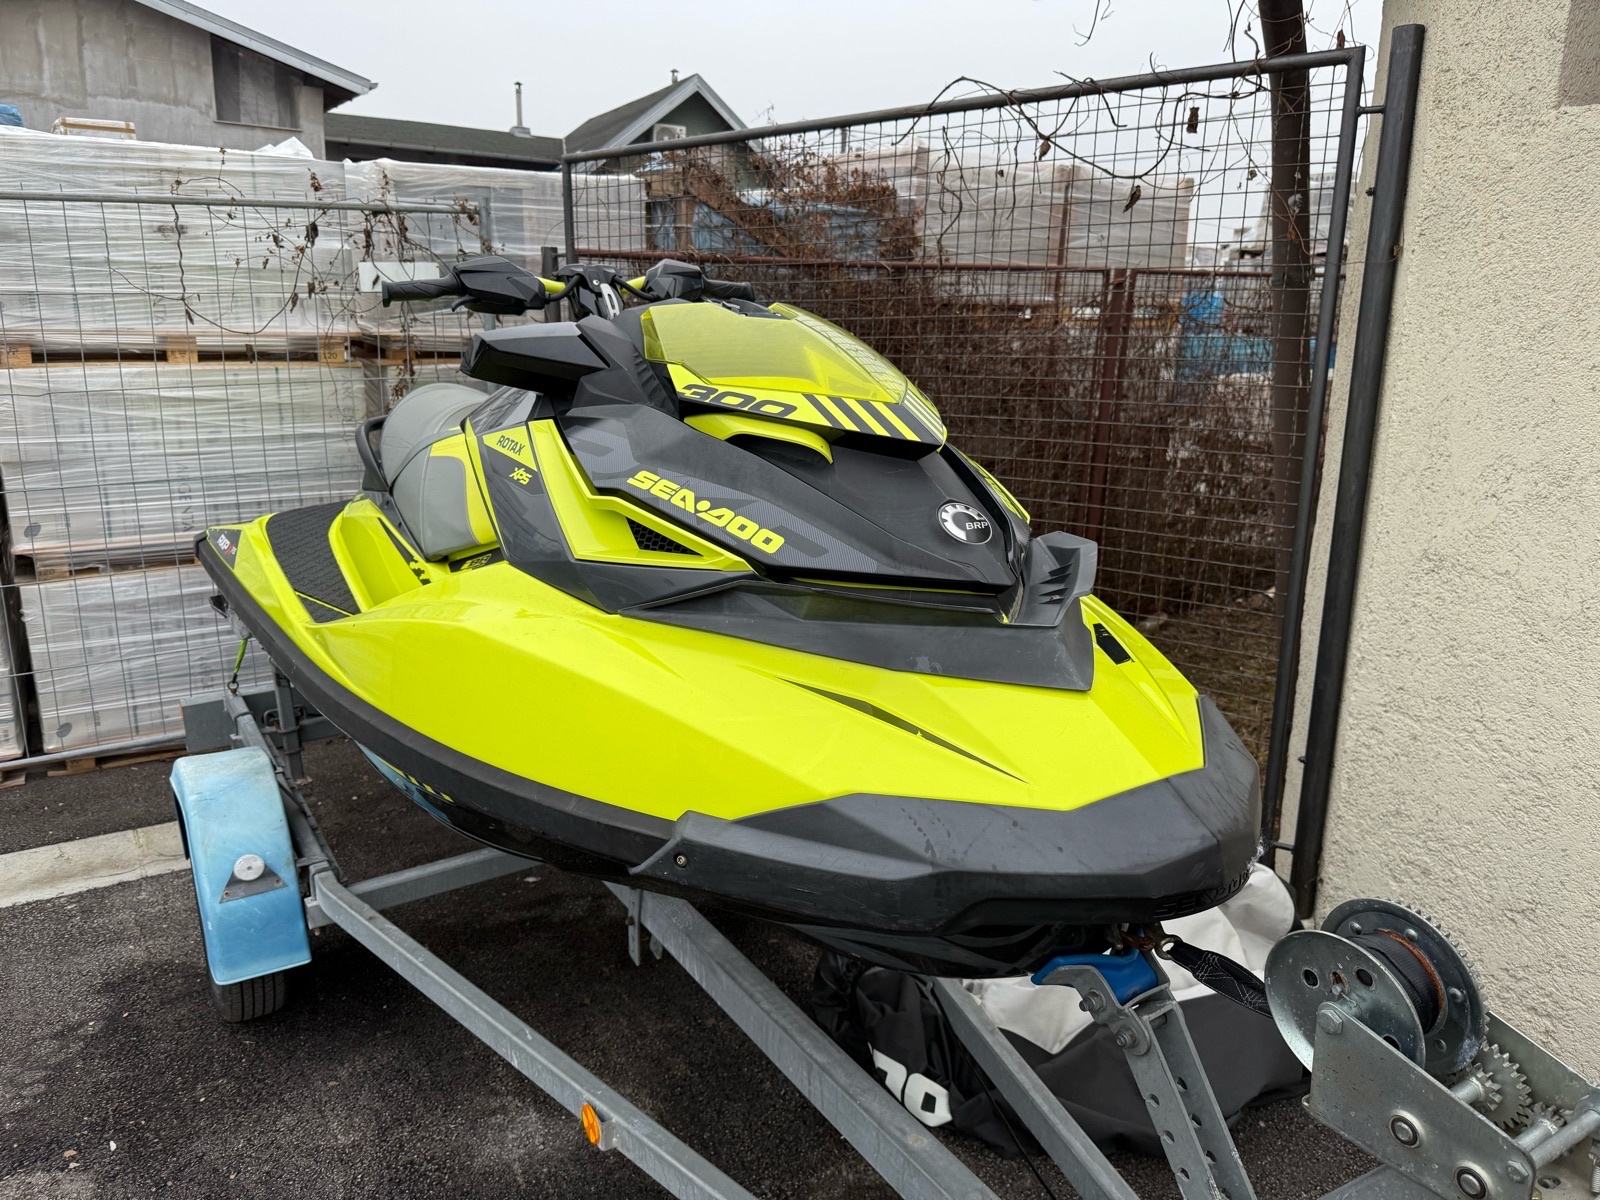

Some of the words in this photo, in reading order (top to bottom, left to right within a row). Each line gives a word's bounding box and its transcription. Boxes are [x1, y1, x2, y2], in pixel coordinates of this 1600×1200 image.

[682, 383, 797, 418] 300
[496, 434, 526, 456] ROTAX
[509, 467, 532, 485] XPS
[965, 521, 988, 530] BRP
